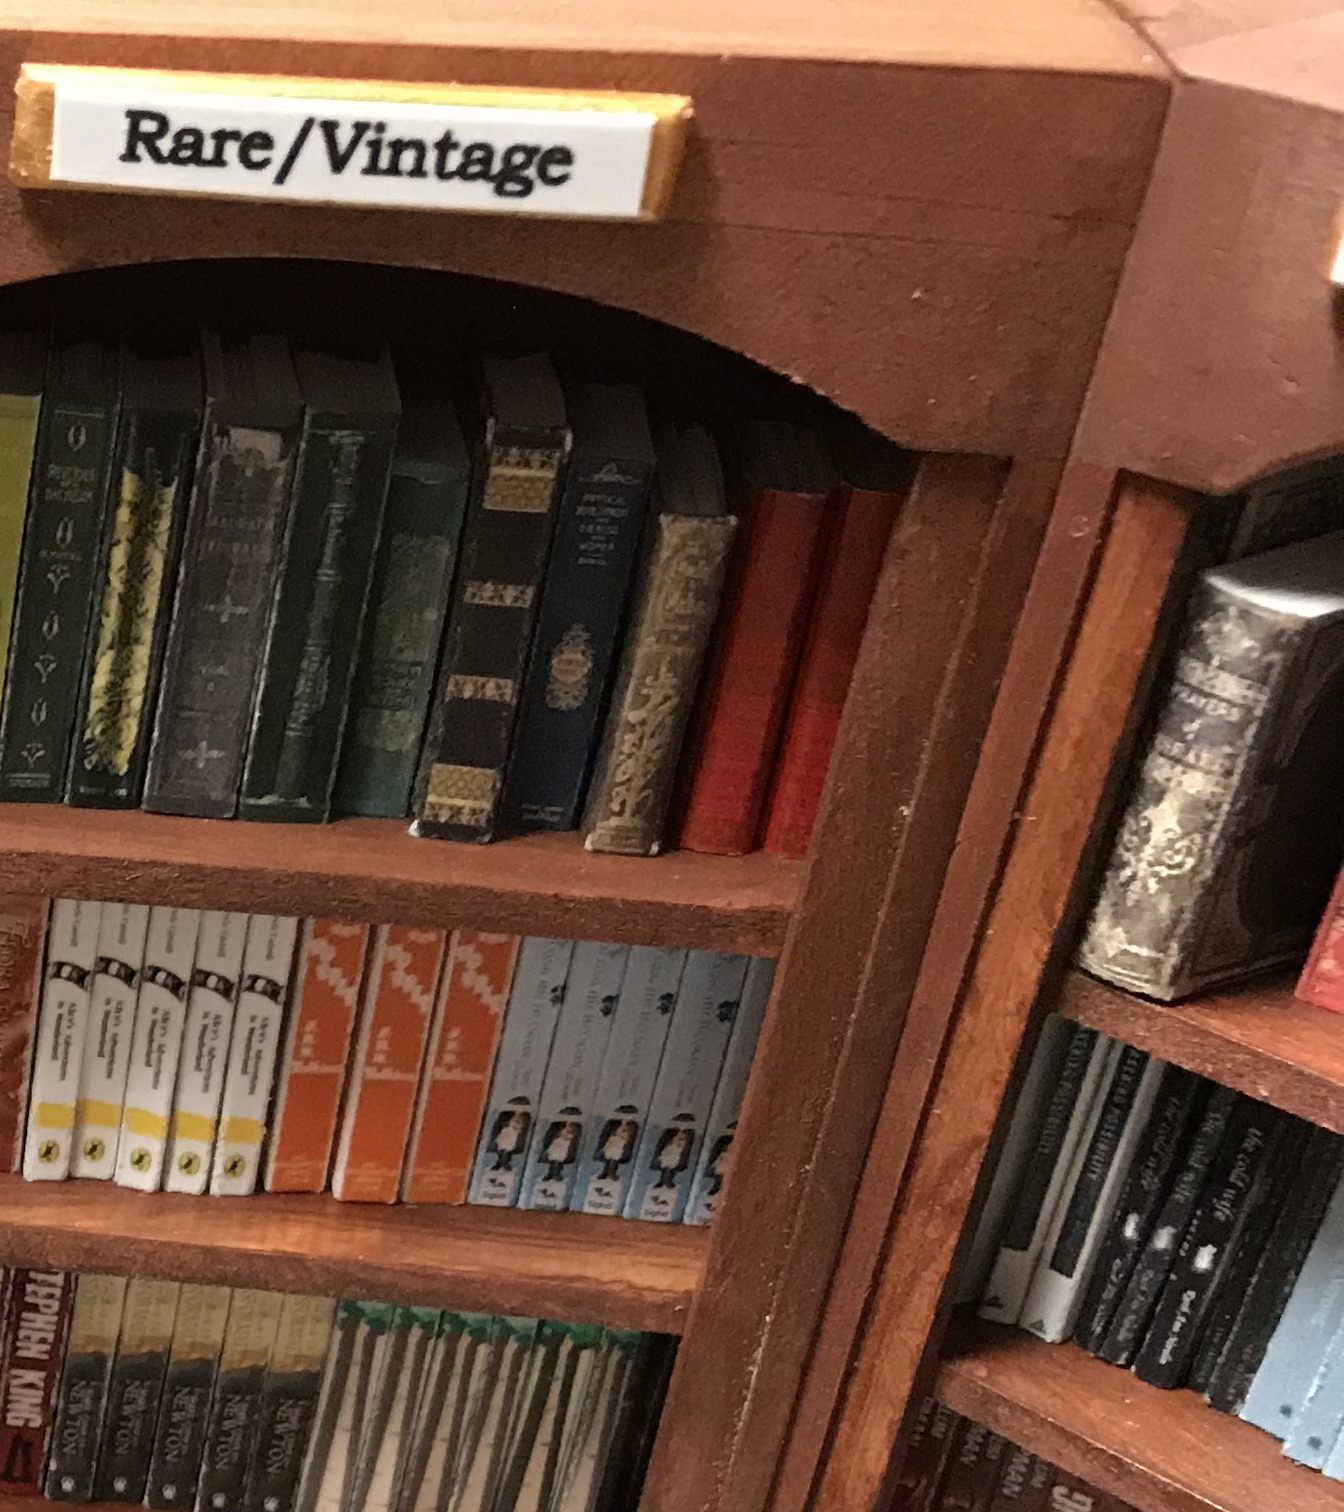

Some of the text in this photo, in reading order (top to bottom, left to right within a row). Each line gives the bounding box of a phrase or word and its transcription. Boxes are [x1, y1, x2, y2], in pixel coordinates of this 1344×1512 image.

[119, 109, 573, 199] Rare/Vintage
[1206, 1125, 1270, 1226] the cold wife
[6, 1271, 65, 1428] TEPHEN KING
[62, 1379, 88, 1455] NEWTON
[115, 1379, 139, 1455] NEWTON
[165, 1386, 190, 1462] NEWTON
[214, 1394, 242, 1470] NEWTON
[267, 1398, 293, 1473] NEWTON
